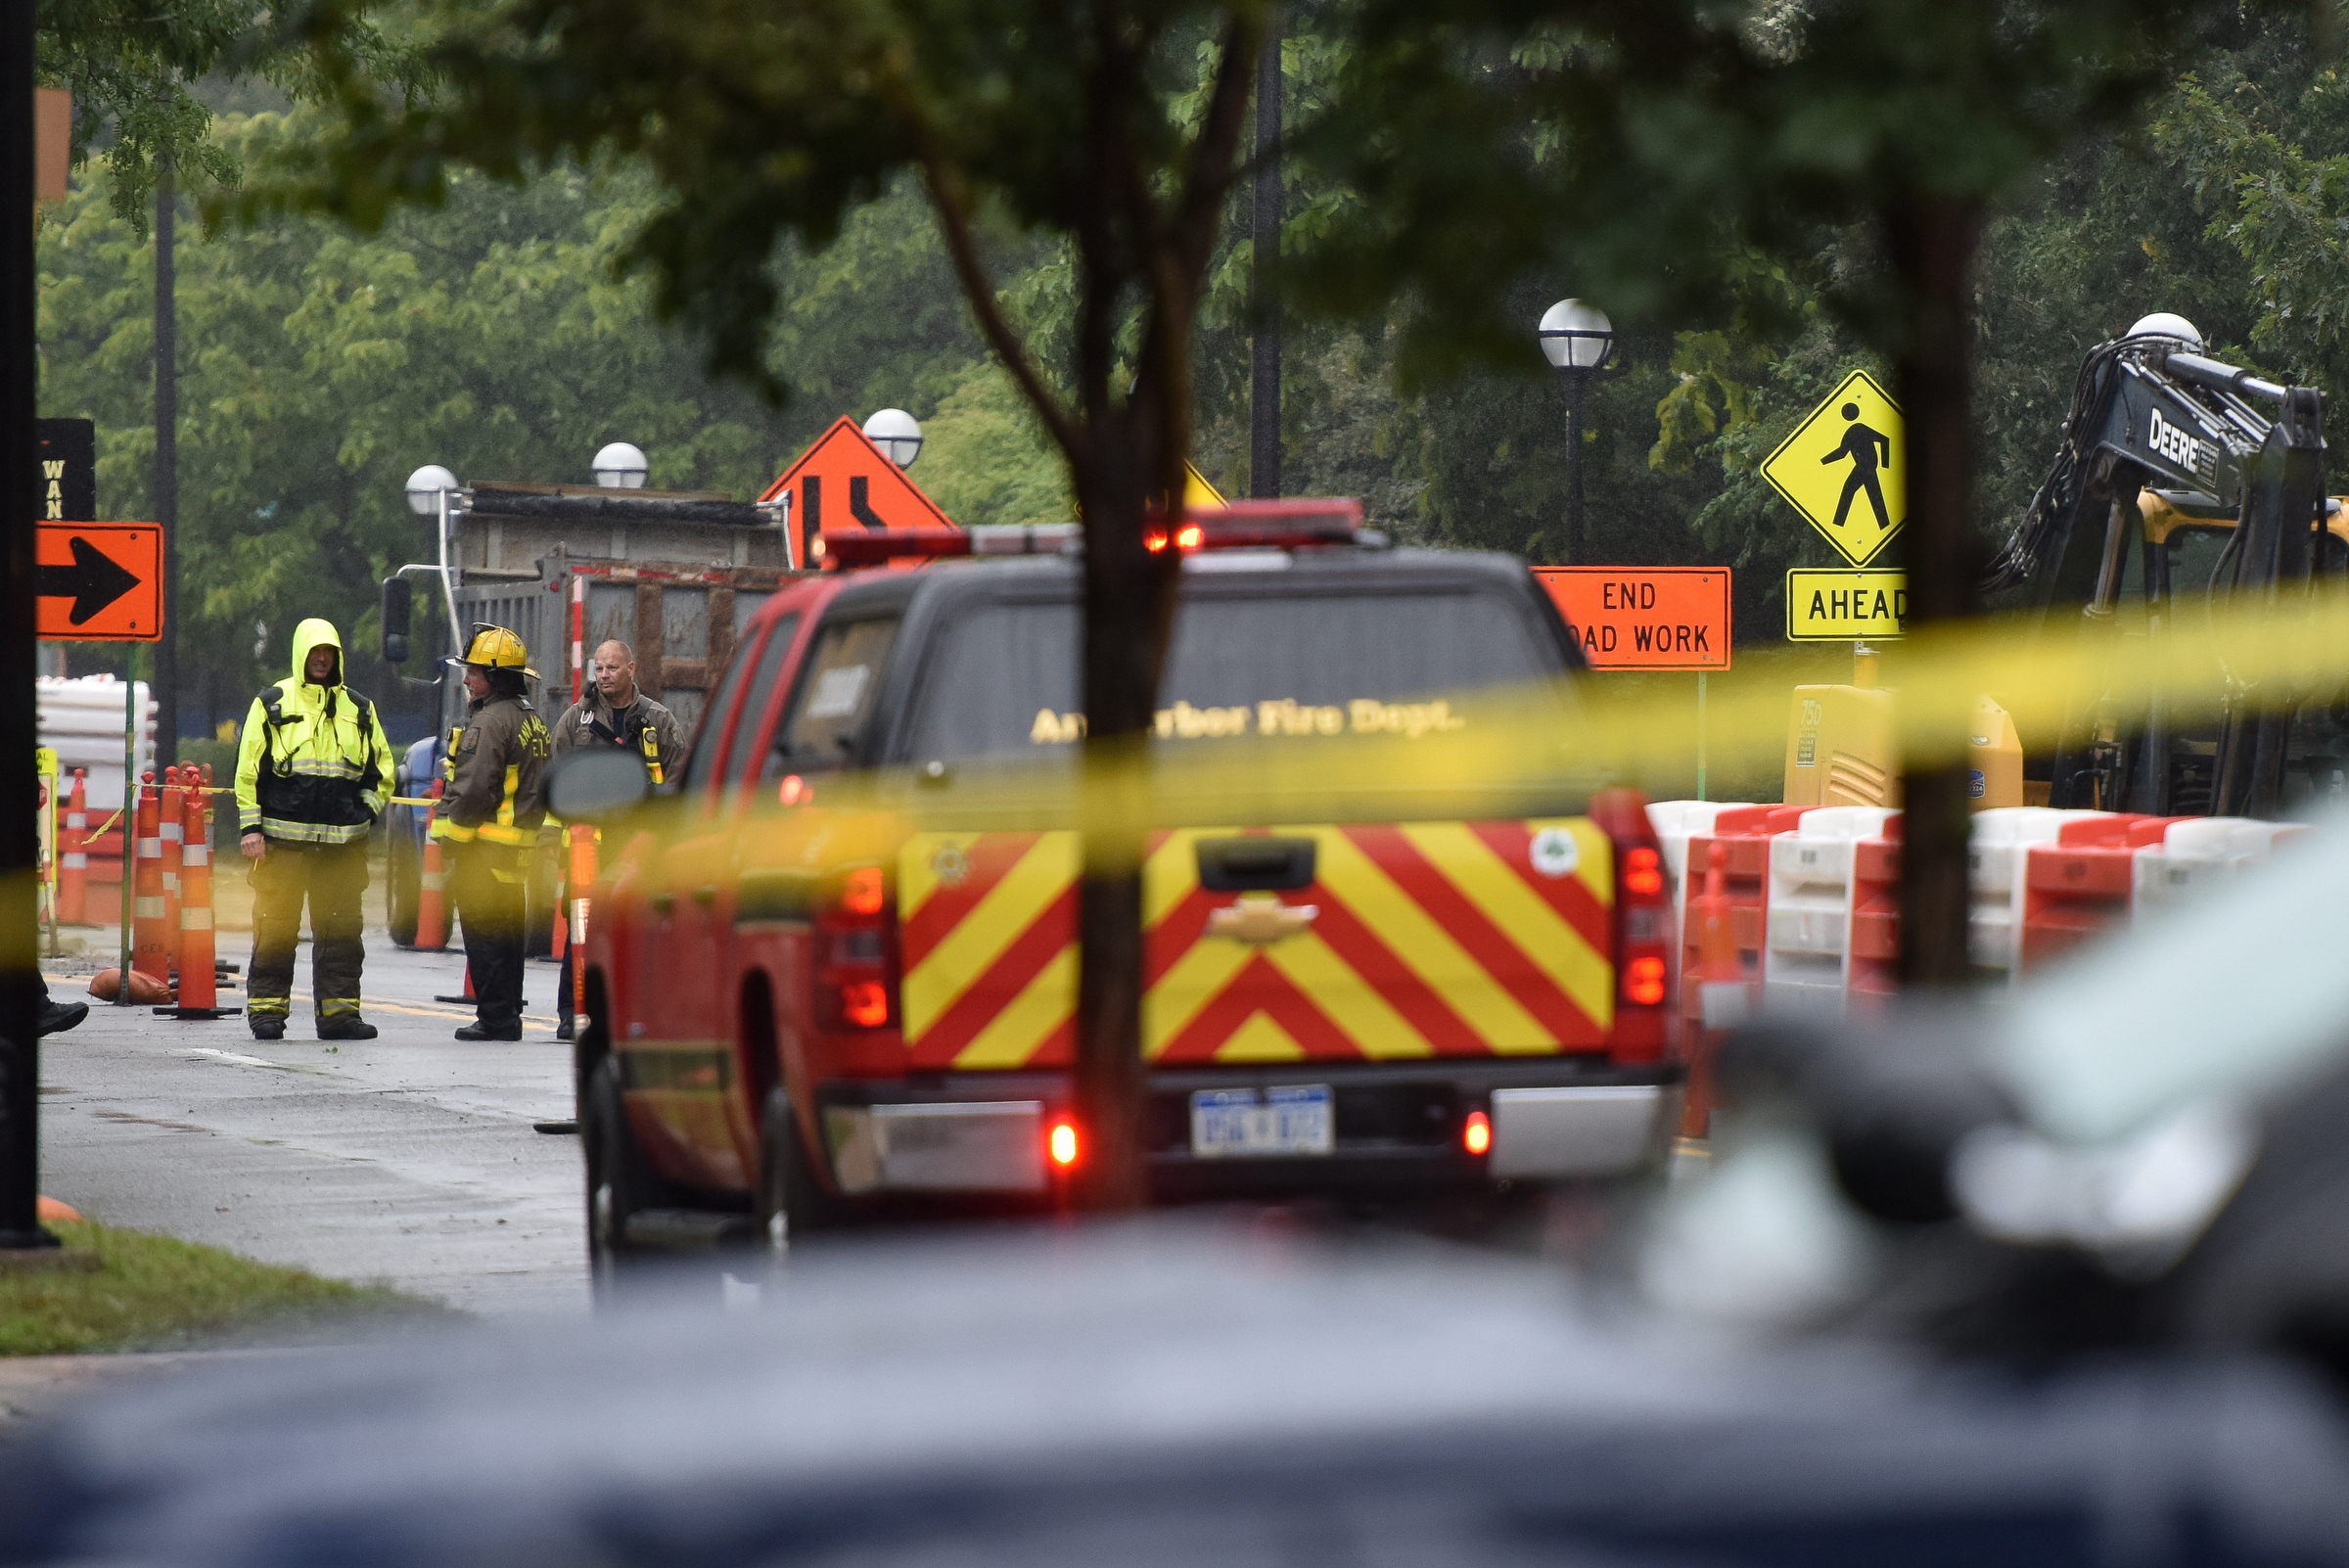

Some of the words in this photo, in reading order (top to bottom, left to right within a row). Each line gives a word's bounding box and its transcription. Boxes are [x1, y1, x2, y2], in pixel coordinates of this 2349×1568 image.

[2148, 407, 2199, 474] DEERE
[42, 460, 66, 521] WAN
[1603, 582, 1656, 609] END
[1809, 589, 1908, 620] AHEAD
[1566, 624, 1617, 652] OAD
[1634, 624, 1709, 652] WORK
[1030, 708, 1088, 745] An
[1148, 700, 1250, 739] rbor
[1258, 698, 1344, 735] Fire
